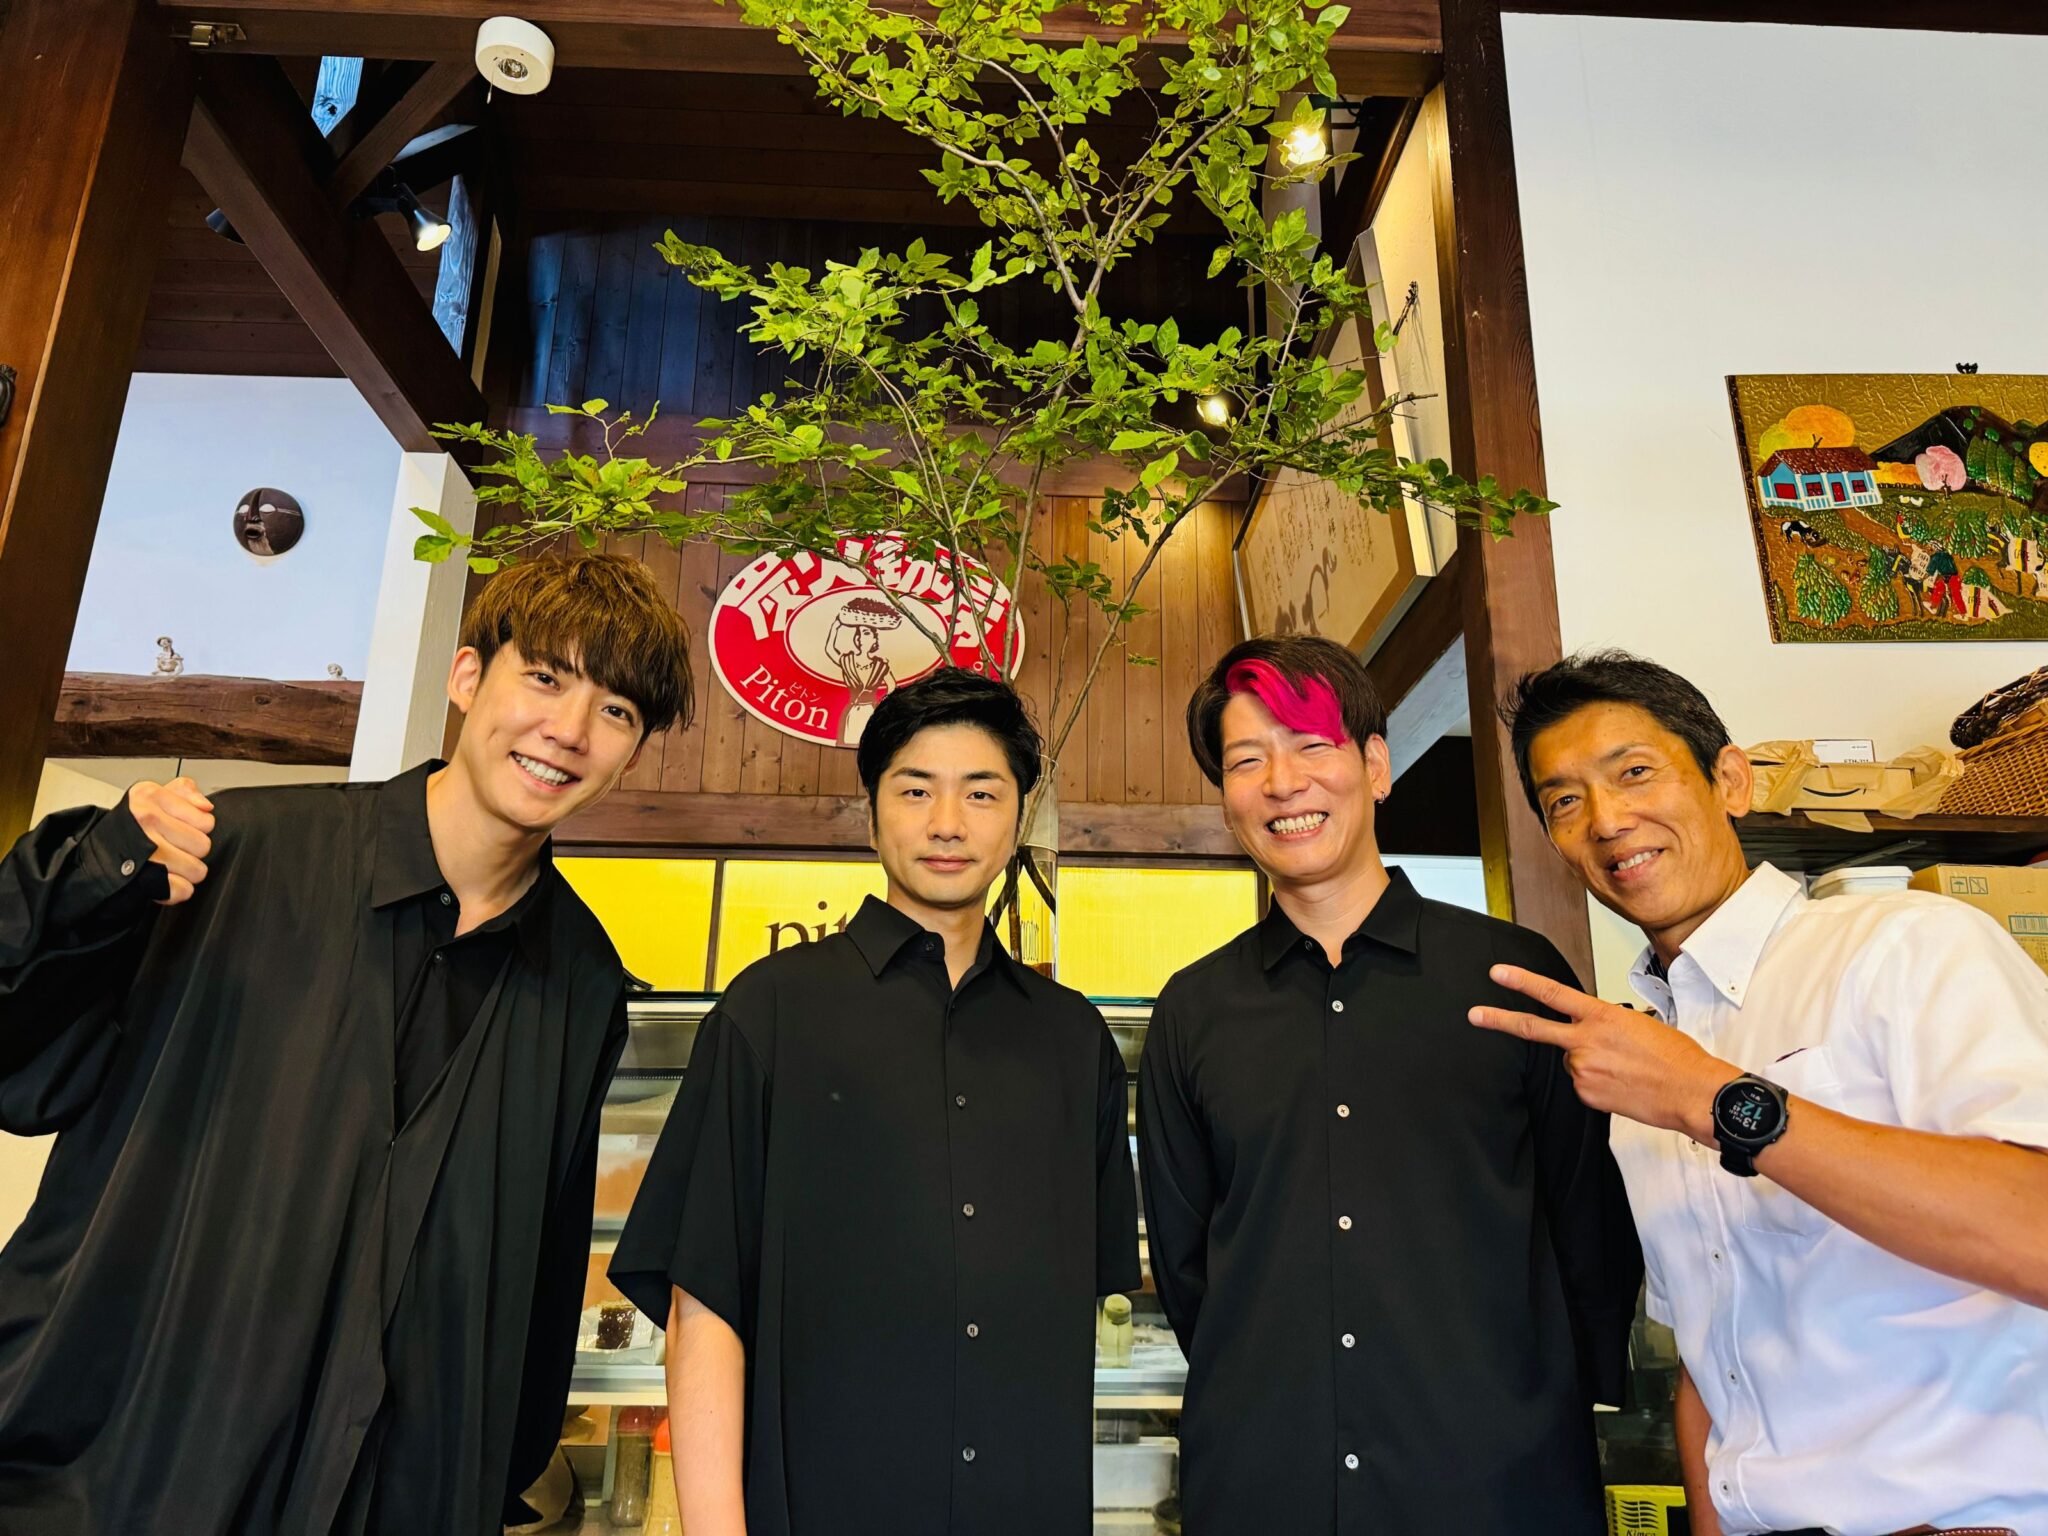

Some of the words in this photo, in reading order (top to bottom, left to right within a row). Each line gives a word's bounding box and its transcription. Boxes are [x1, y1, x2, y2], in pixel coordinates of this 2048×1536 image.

[740, 664, 830, 730] Piton
[789, 682, 821, 703] ピトン
[1741, 1100, 1762, 1120] 12
[1742, 1117, 1757, 1130] 13
